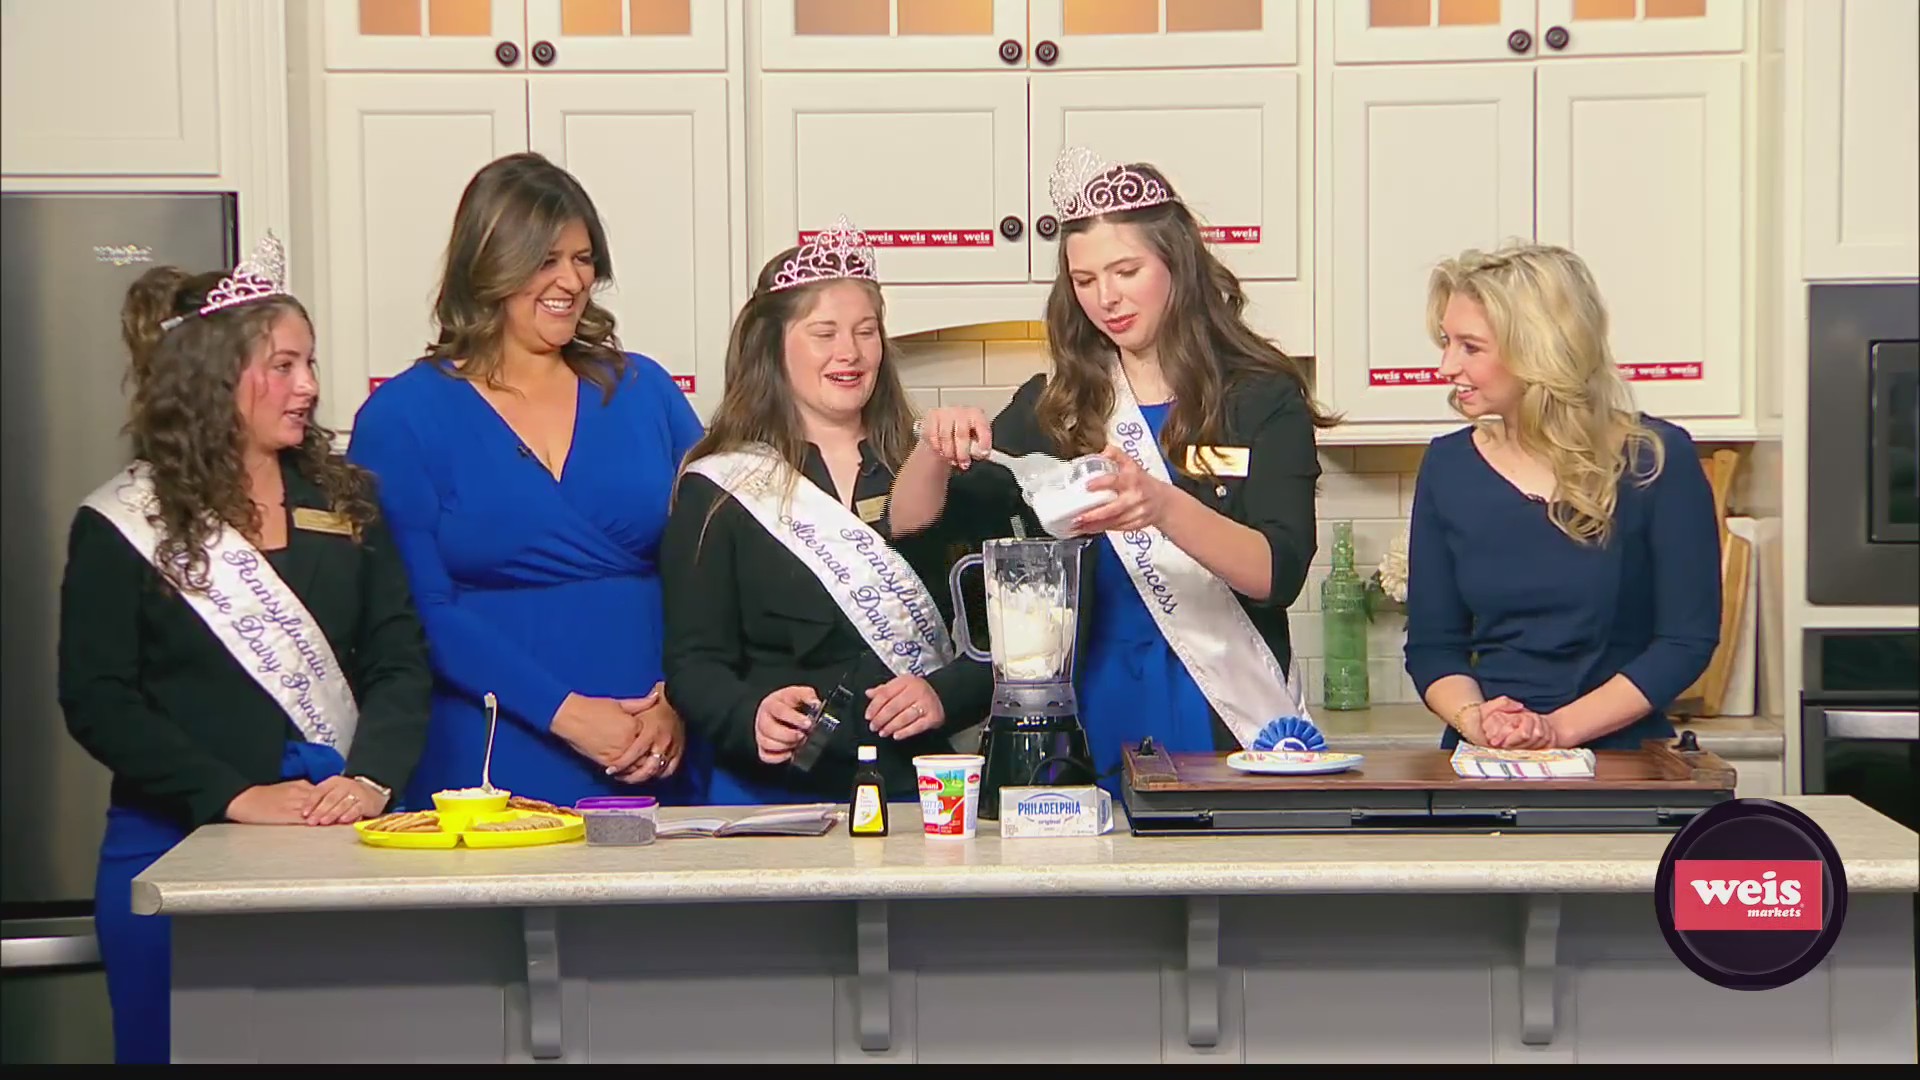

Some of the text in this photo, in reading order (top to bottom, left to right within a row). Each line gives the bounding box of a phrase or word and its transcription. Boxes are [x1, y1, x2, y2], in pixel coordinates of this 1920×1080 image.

[867, 232, 894, 243] weis
[899, 232, 926, 243] weis
[931, 232, 958, 243] weis
[963, 231, 990, 243] weis
[1231, 228, 1258, 239] weis
[1372, 370, 1400, 381] weis
[1403, 370, 1431, 380] weis
[1637, 365, 1667, 376] weis
[1669, 364, 1698, 375] weis
[779, 515, 851, 586] Alternate
[850, 584, 896, 641] Dairy
[840, 529, 938, 646] Pennsylvania
[1123, 530, 1178, 616] Princess
[222, 549, 326, 681] Pennsylvania
[231, 615, 337, 746] Dairy Princess
[1017, 800, 1081, 816] PHILADELPHIA
